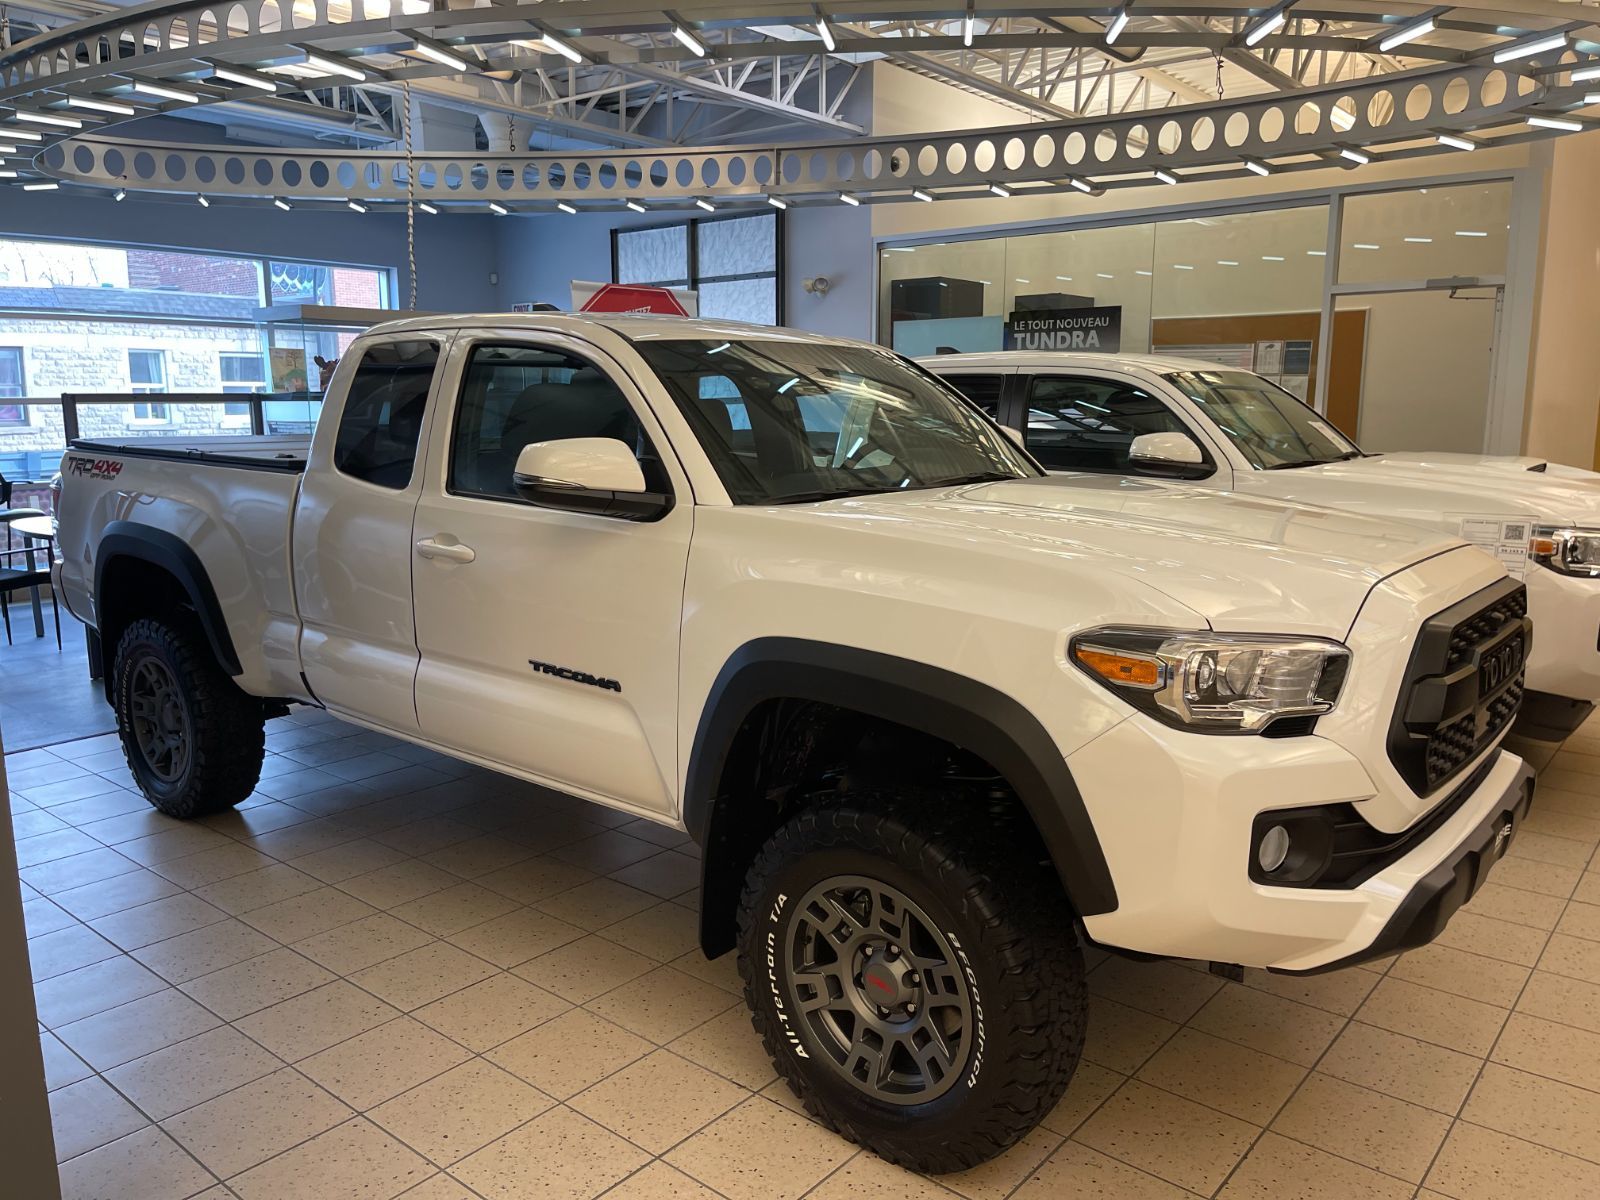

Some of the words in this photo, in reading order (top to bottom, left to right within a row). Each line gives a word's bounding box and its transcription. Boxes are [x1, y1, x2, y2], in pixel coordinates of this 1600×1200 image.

[1014, 321, 1025, 331] LE
[1027, 320, 1055, 331] TOUT
[1056, 316, 1110, 329] NOUVEAU
[1013, 330, 1101, 350] TUNDRA
[528, 659, 622, 693] TACOMA
[769, 893, 788, 923] T/A
[767, 932, 810, 1059] All-Terrain
[947, 932, 986, 1089] BFGoodrich
